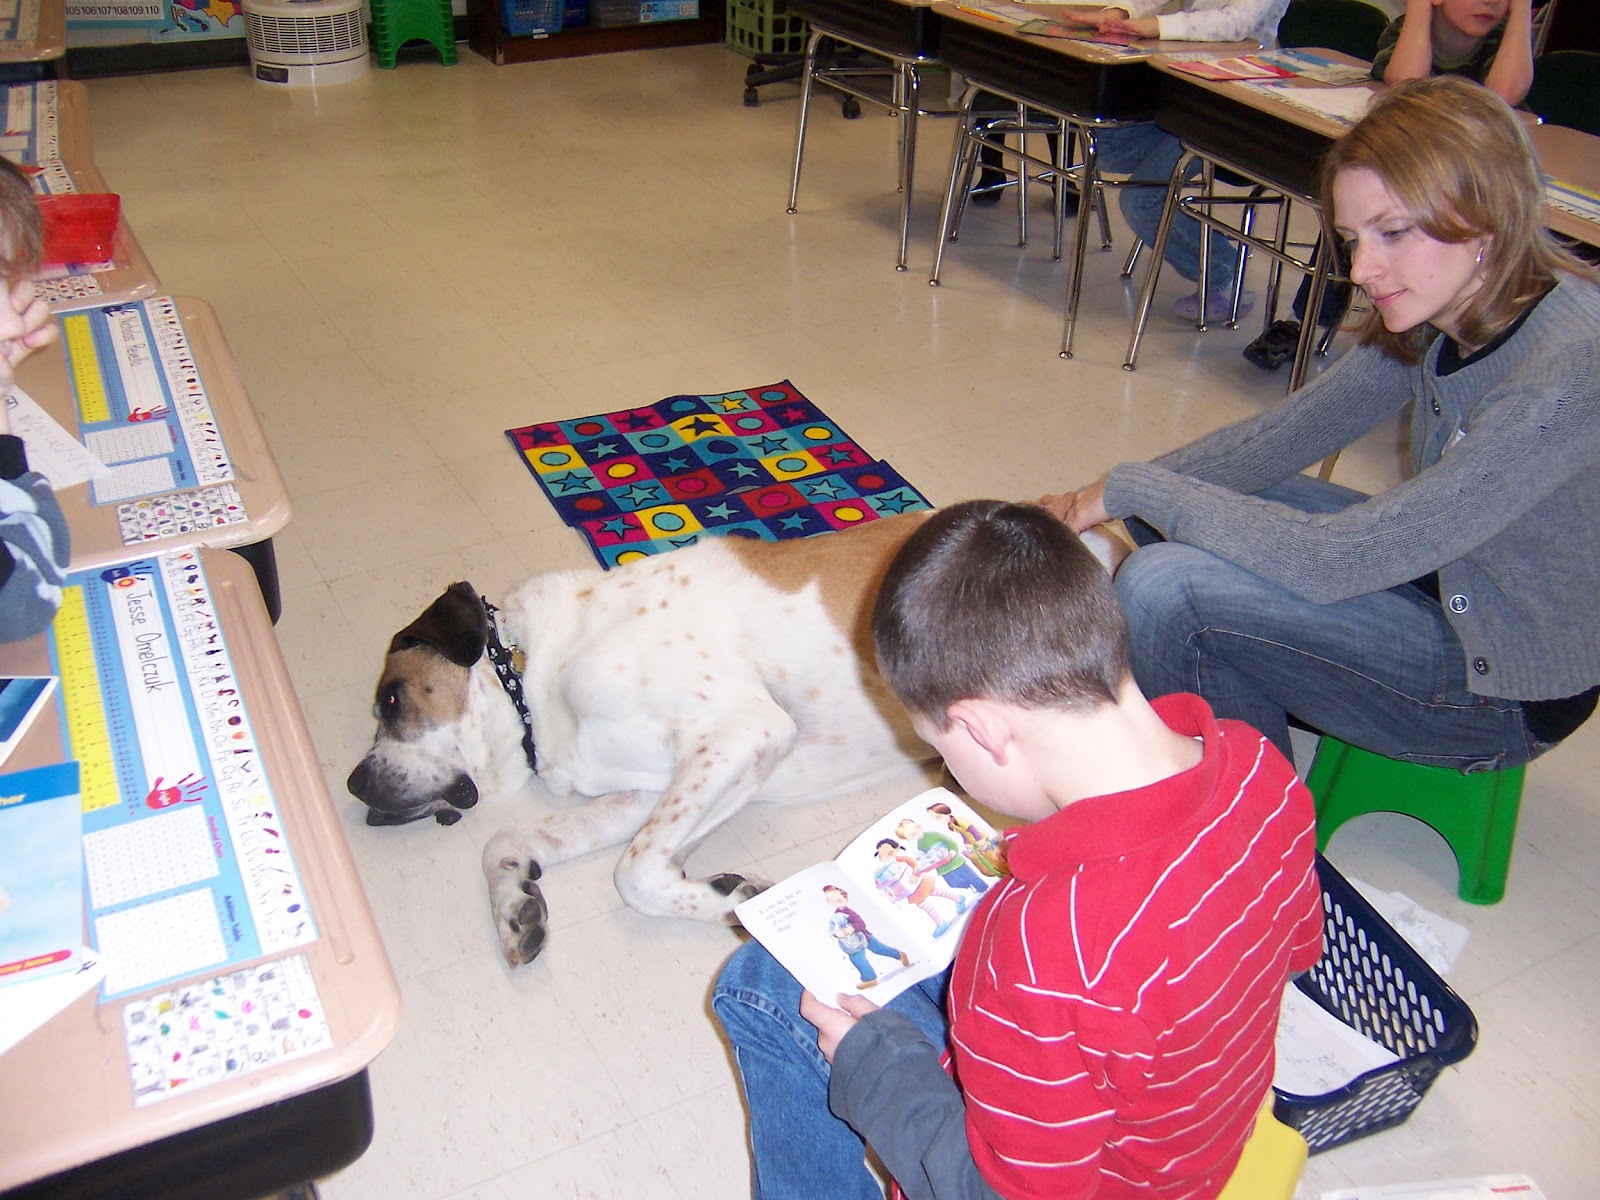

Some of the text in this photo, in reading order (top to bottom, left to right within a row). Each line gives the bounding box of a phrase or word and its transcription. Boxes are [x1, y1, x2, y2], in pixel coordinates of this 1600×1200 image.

[66, 5, 159, 15] 105 106 107 108 109 110
[126, 589, 175, 694] Jesse Omelczuk
